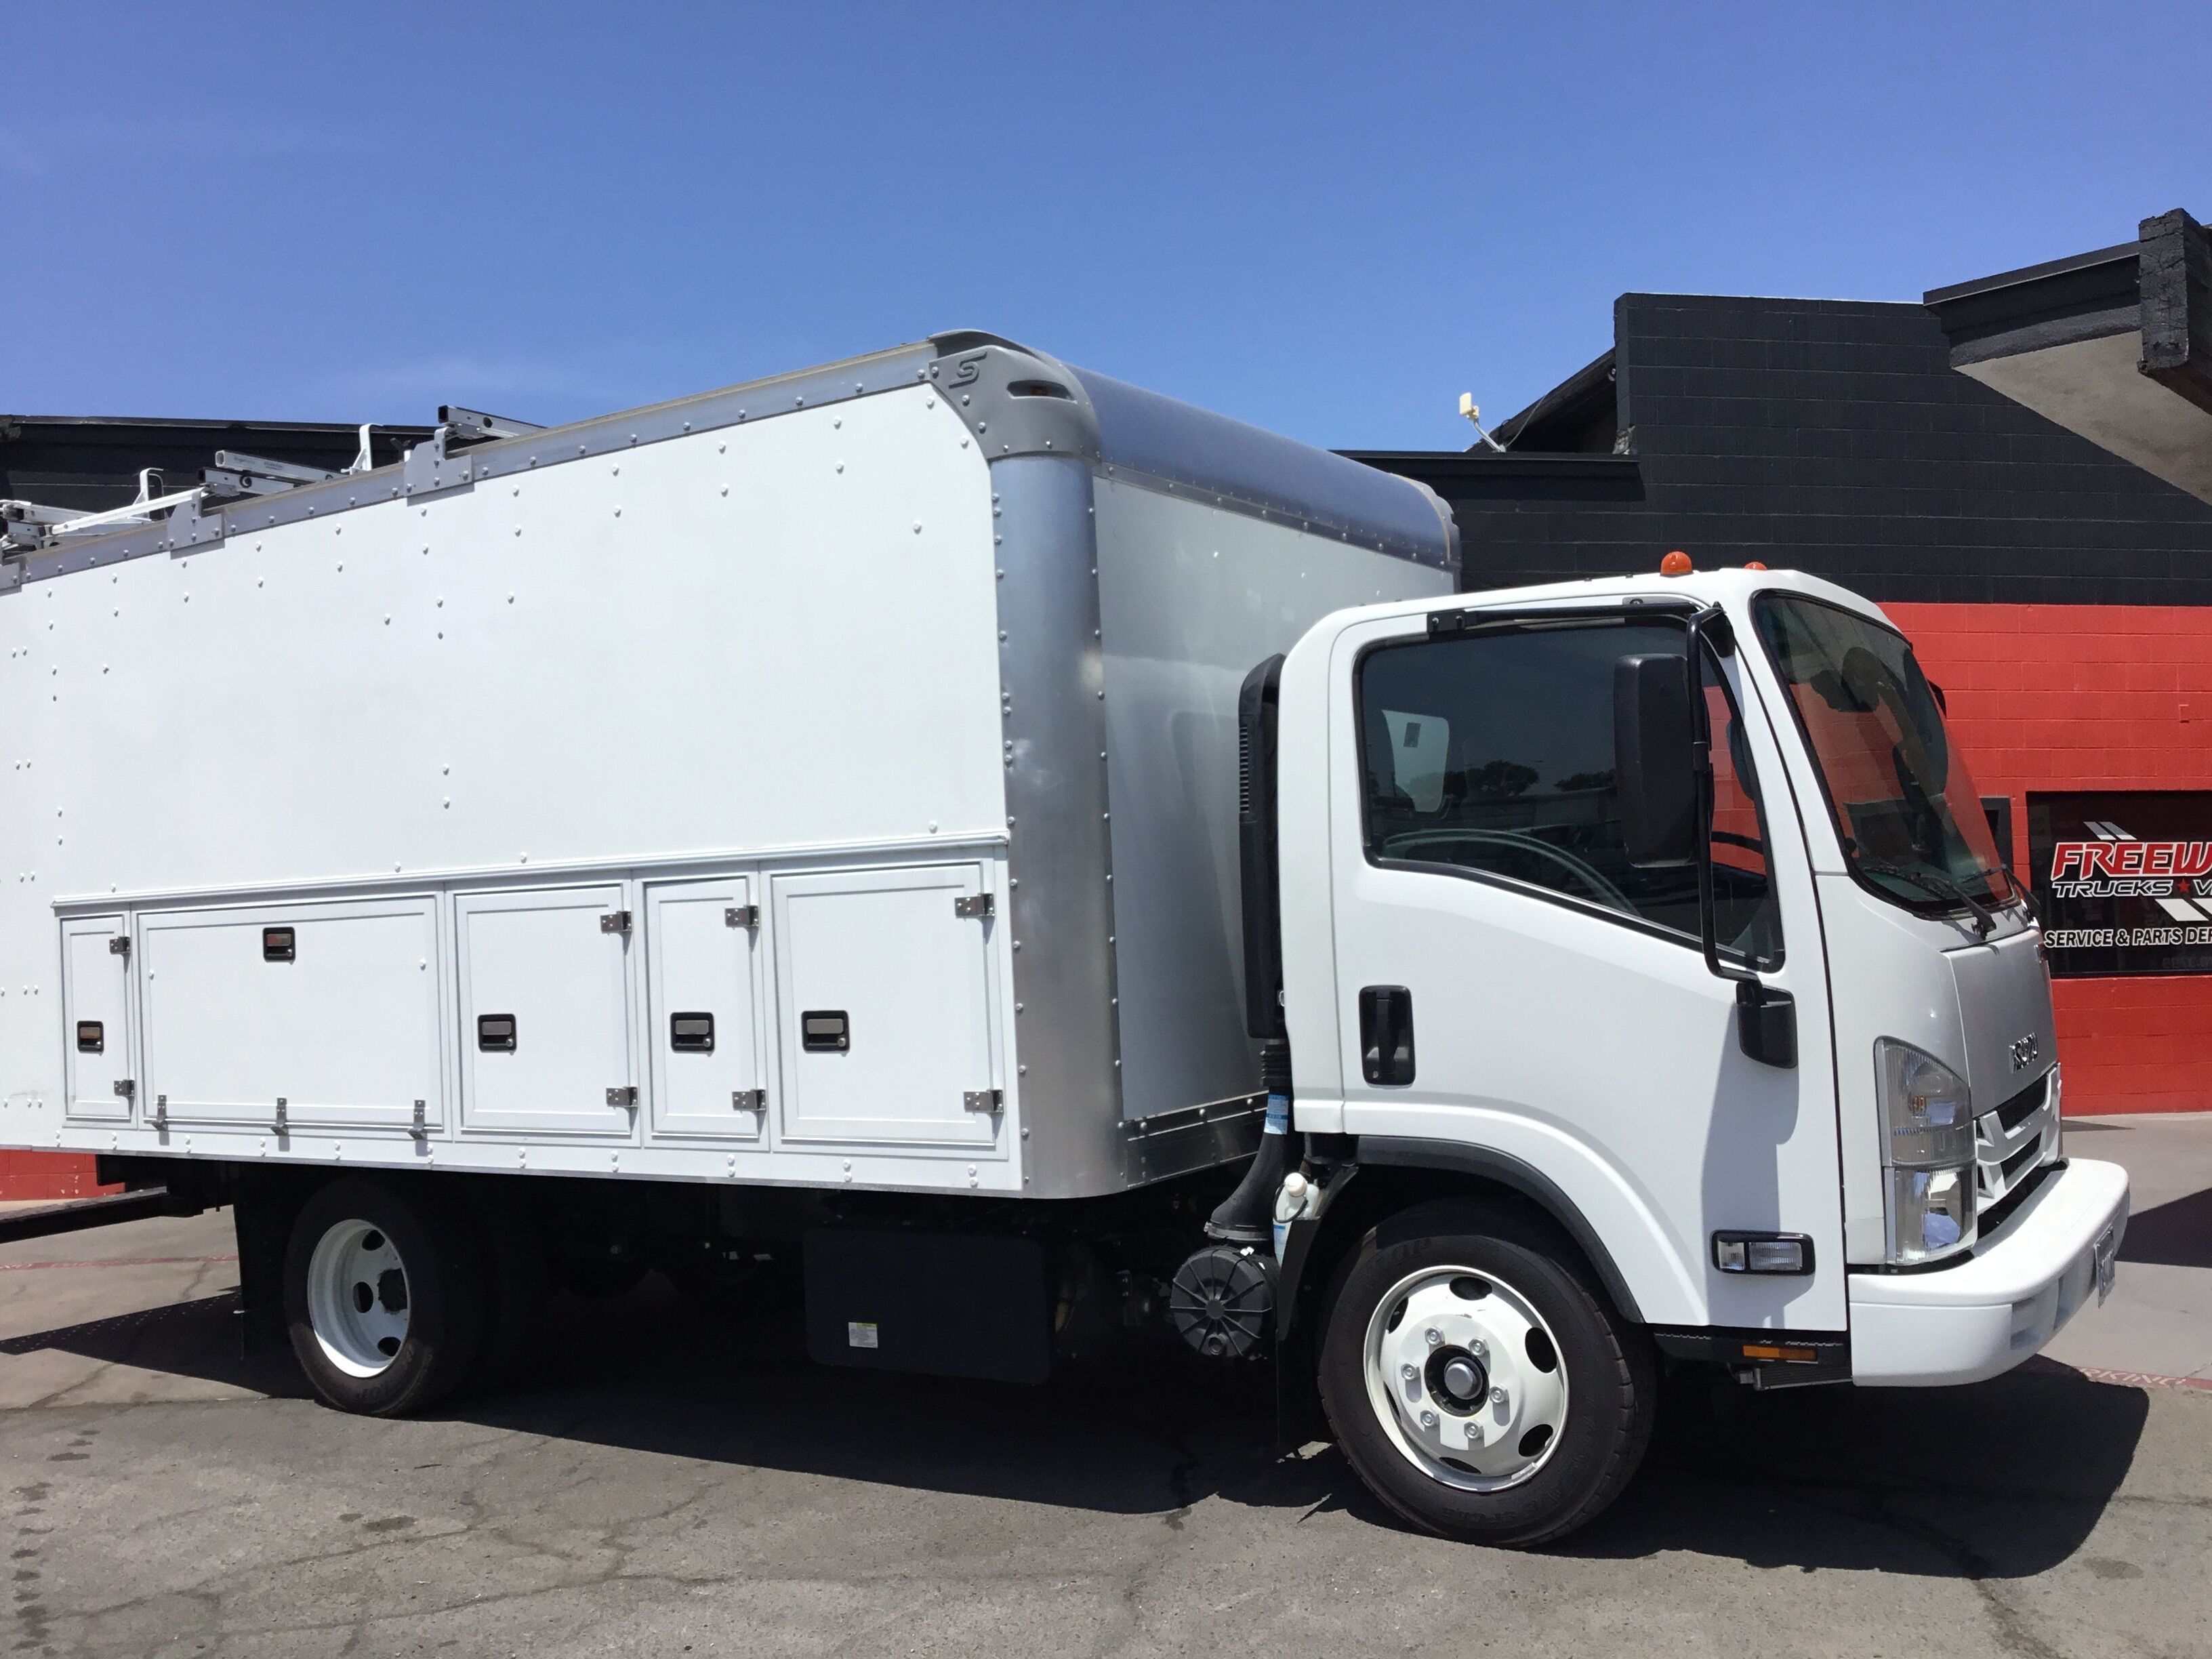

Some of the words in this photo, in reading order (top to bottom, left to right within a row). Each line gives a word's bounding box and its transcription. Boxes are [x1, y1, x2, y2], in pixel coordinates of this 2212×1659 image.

[2052, 879, 2173, 898] TRUCKS
[2044, 929, 2113, 947] SERVICE
[2116, 928, 2130, 947] &
[2132, 927, 2183, 945] PARTS
